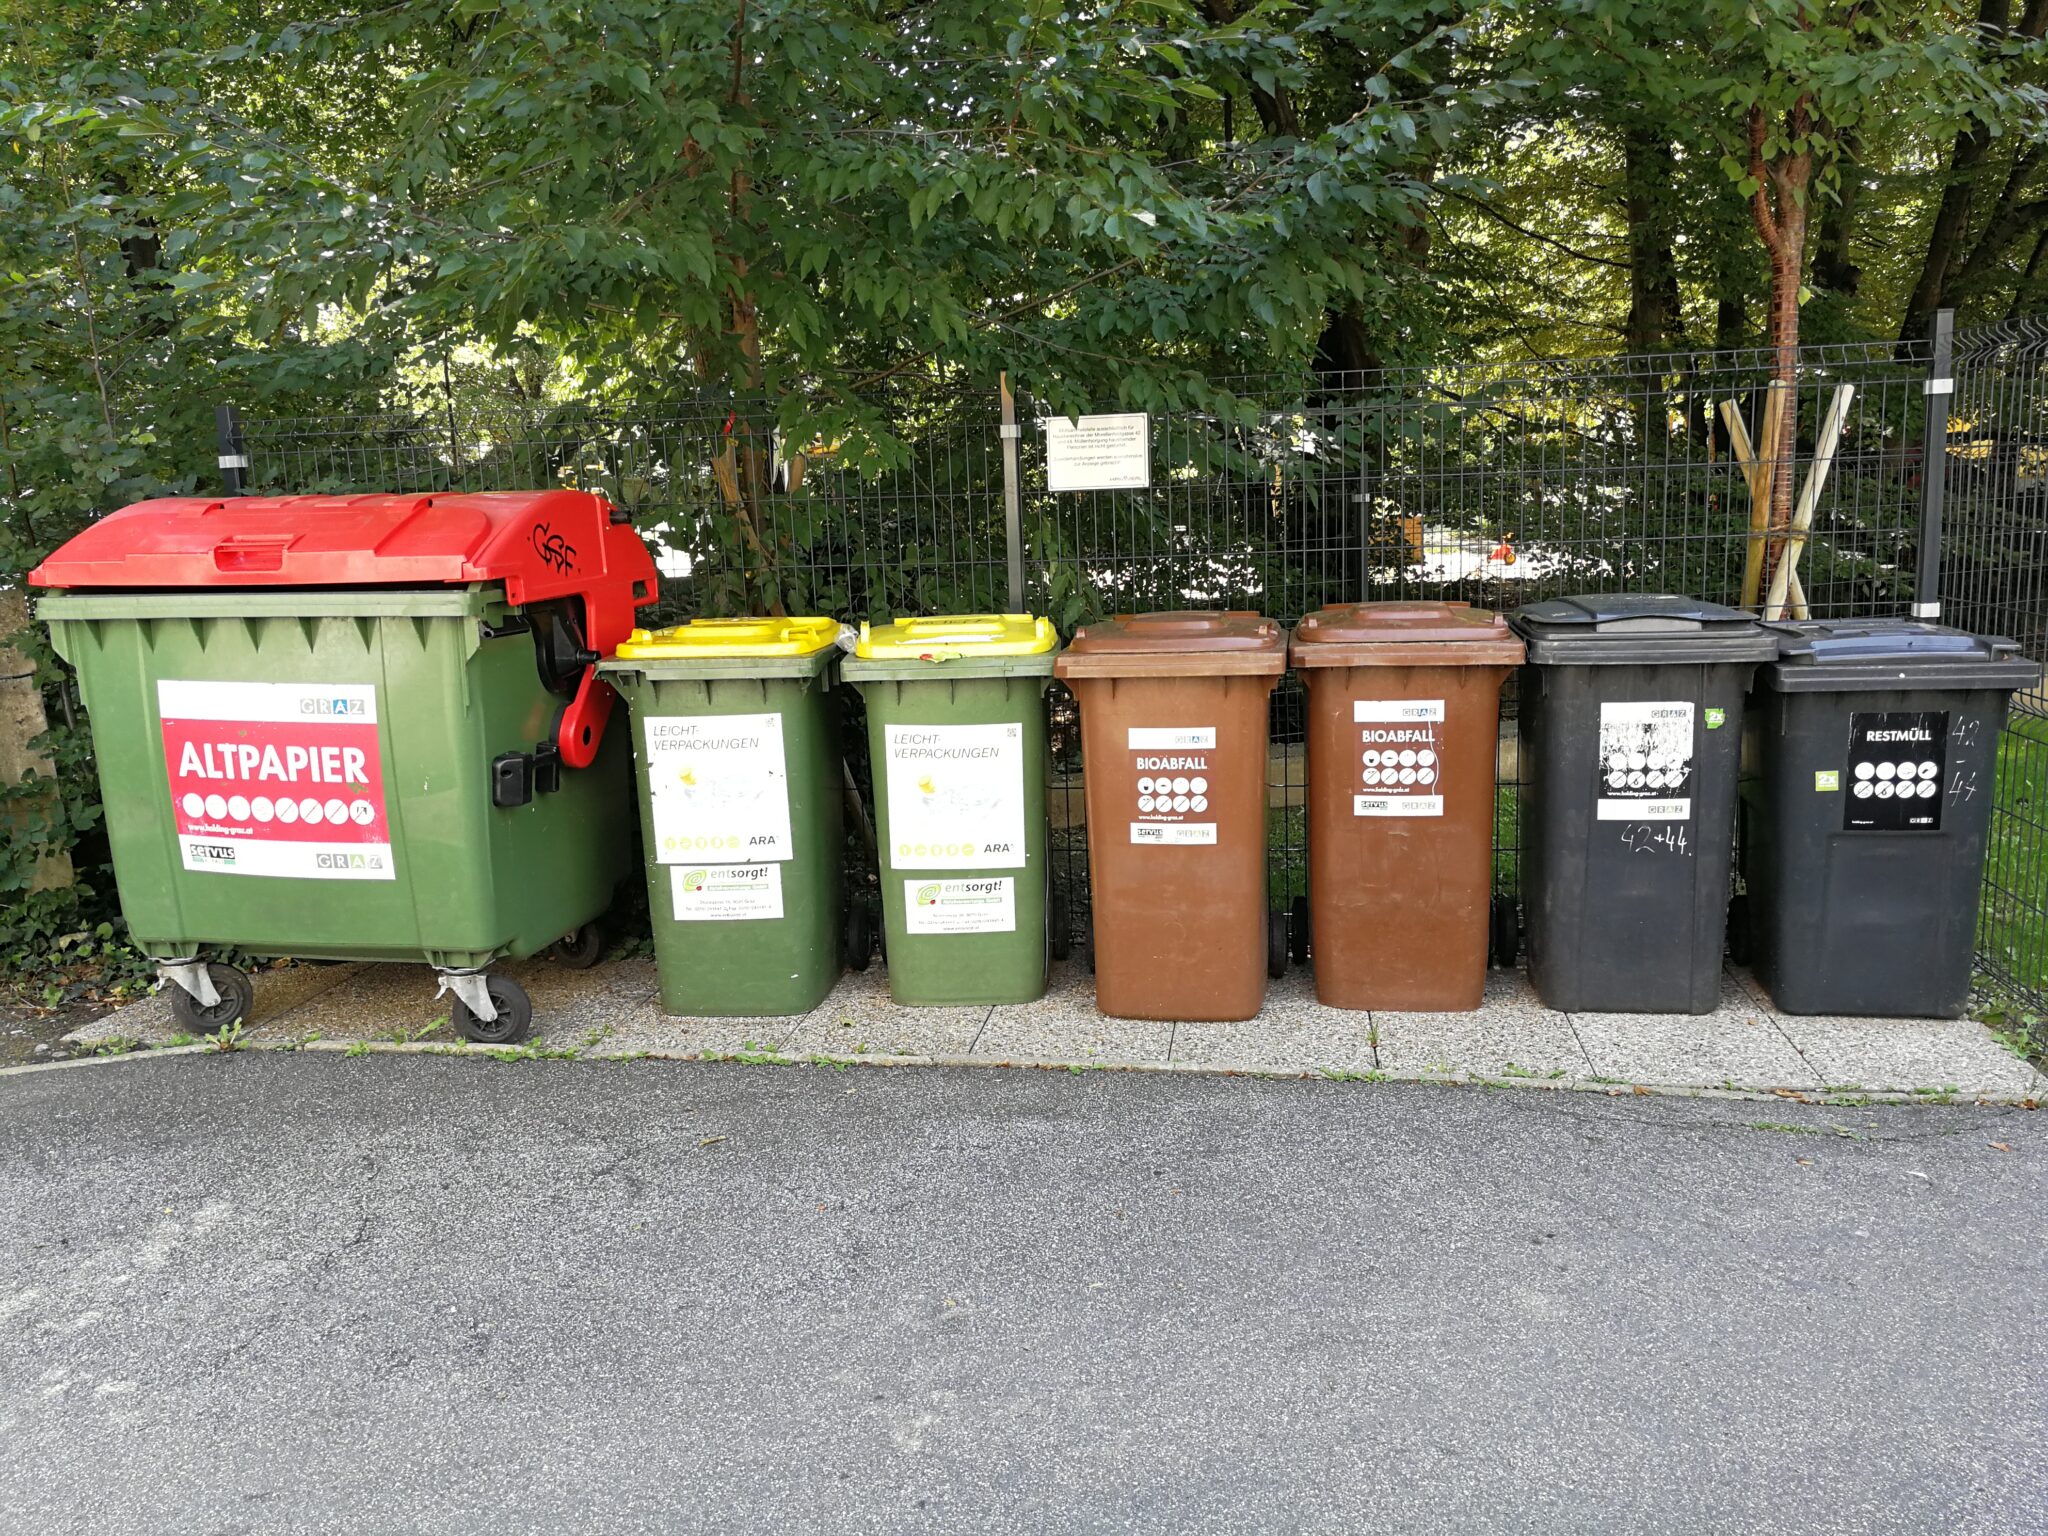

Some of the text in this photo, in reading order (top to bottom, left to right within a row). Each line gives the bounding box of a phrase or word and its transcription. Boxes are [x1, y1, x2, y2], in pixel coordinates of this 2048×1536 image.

[300, 699, 365, 715] GRAZ
[653, 725, 700, 737] LEICHT-
[1361, 729, 1436, 743] BIOABFALL
[1866, 728, 1932, 742] RESTMÜLL
[653, 738, 760, 751] VERPACKUNGEN
[894, 734, 941, 745] LEICHT-
[894, 747, 1000, 759] VERPACKUNGEN
[179, 741, 370, 784] ALTPAPIER
[1136, 757, 1208, 770] BIOABFALL
[749, 836, 776, 846] ARA
[984, 843, 1011, 853] ARA
[316, 853, 383, 869] GRAZ
[710, 867, 769, 880] entsorgt!
[945, 880, 1003, 893] entsorgt!
